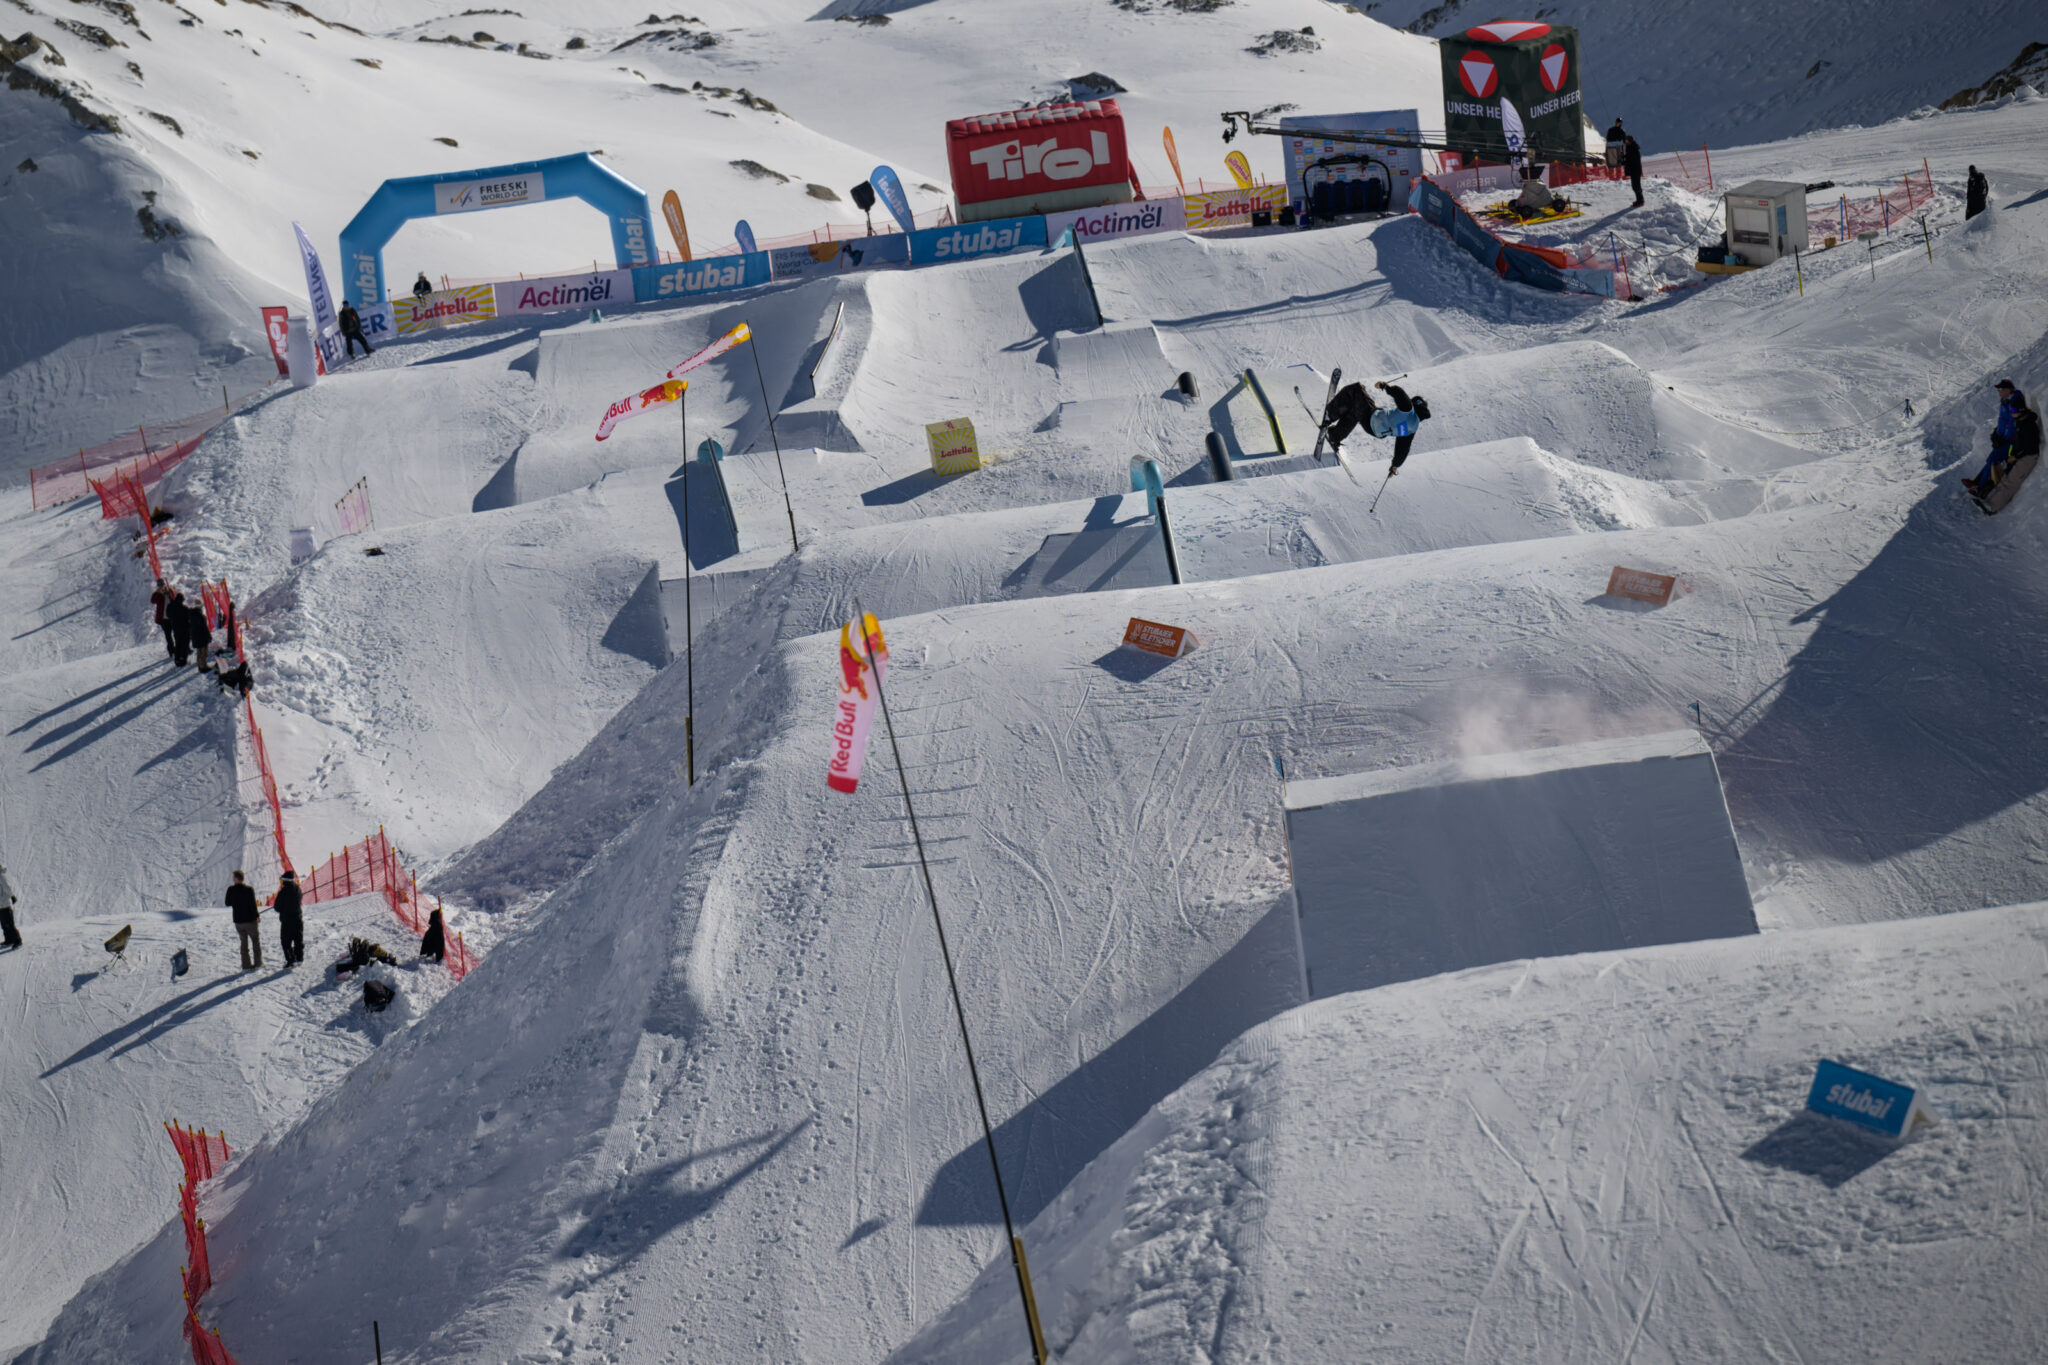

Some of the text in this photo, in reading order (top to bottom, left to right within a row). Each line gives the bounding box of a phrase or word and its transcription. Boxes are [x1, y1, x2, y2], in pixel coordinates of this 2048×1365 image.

[1447, 101, 1501, 119] UNSER HE
[1530, 89, 1581, 119] UNSER HEER
[969, 130, 1111, 181] Tirol
[480, 180, 527, 194] FREESKI
[480, 189, 528, 202] WORLD CUP
[1075, 205, 1163, 236] Actimel
[1202, 197, 1272, 219] Lattella
[934, 222, 1022, 257] stubai
[657, 259, 746, 295] stubai
[518, 276, 612, 309] Actimel
[412, 296, 478, 322] Lattella
[610, 397, 632, 418] Bull
[831, 701, 857, 773] Red Bull
[1826, 1082, 1896, 1120] stubai
